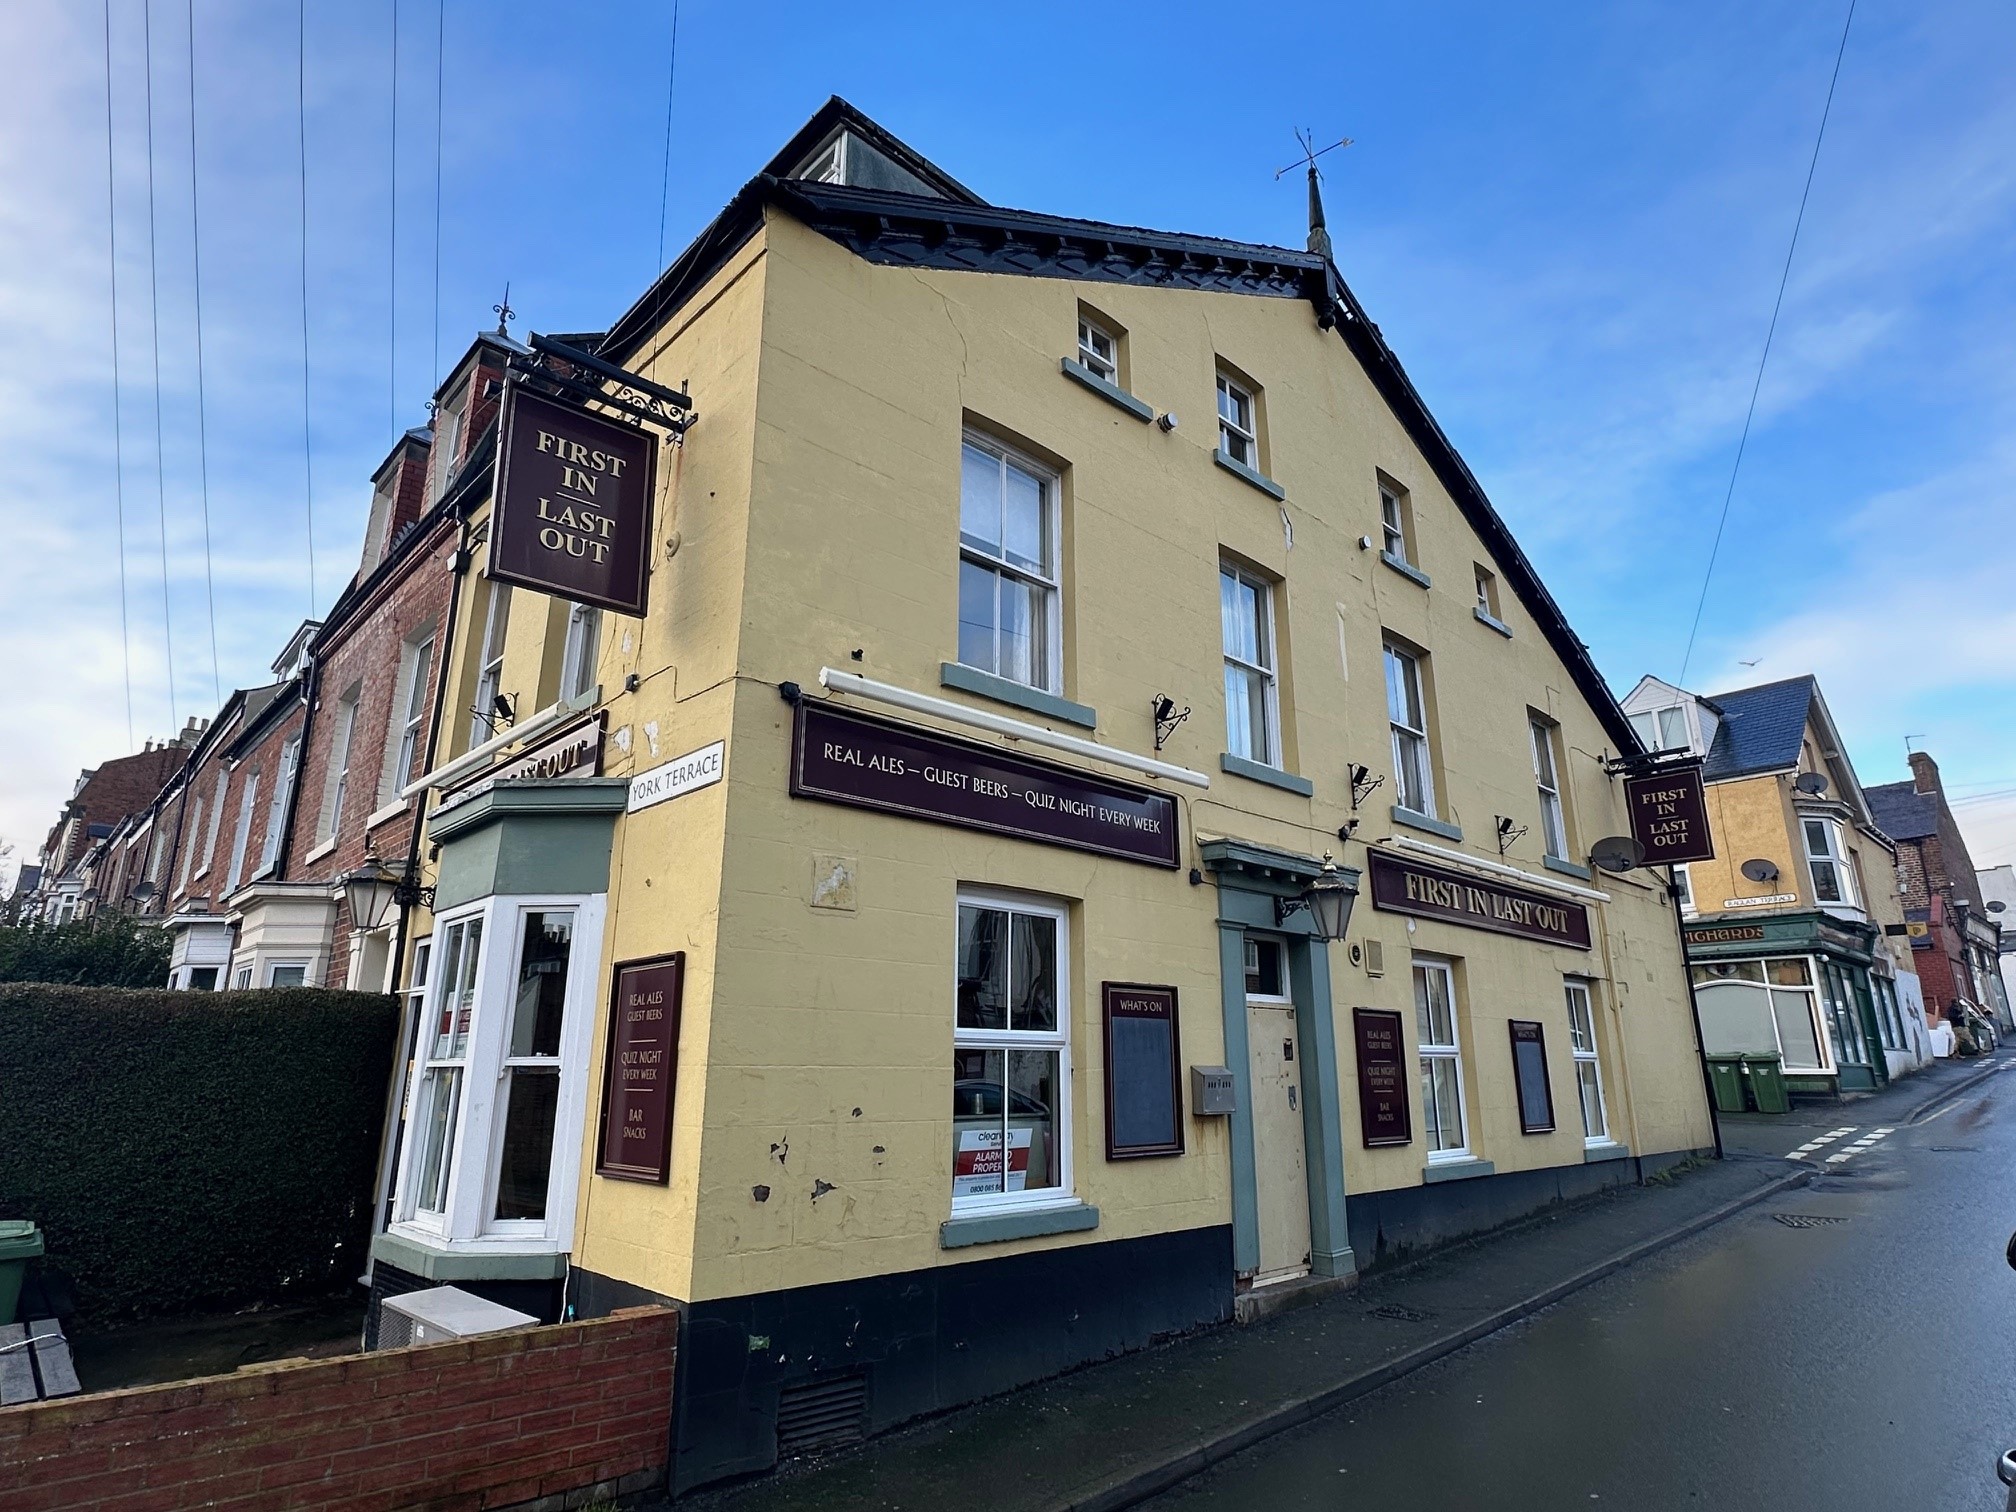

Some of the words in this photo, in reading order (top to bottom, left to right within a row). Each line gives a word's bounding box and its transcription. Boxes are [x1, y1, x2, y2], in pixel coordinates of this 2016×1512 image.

[536, 430, 626, 478] FIRST
[562, 466, 598, 496] IN
[536, 498, 616, 539] LAST
[540, 528, 610, 564] OUT
[546, 739, 588, 779] OUT
[633, 776, 661, 802] YORK
[665, 753, 719, 790] TERRACE
[823, 742, 864, 767] REAL
[868, 754, 905, 775] ALES
[924, 766, 968, 790] GUEST
[973, 777, 1008, 799] BEERS
[1025, 790, 1056, 810] QUIZ
[1059, 798, 1096, 819] NIGHT
[1100, 807, 1131, 827] EVERY
[1133, 814, 1161, 834] WEEK
[1641, 788, 1687, 804] FIRST
[1657, 803, 1675, 815] IN
[1649, 819, 1689, 834] LAST
[1654, 832, 1689, 846] OUT
[1403, 871, 1461, 910] FIRST
[1465, 886, 1489, 917] IN
[1490, 892, 1533, 926] LAST
[1535, 905, 1568, 934] OUT
[630, 993, 646, 1006] REAL
[647, 990, 663, 1005] ALES
[1119, 999, 1148, 1011] WHAT'S
[1149, 1001, 1163, 1012] ON
[627, 1010, 646, 1022] GUEST
[646, 1008, 663, 1020] BEERS
[620, 1051, 638, 1066] QUIZ
[639, 1050, 662, 1064] NIGHT
[622, 1068, 640, 1080] EVERY
[640, 1068, 657, 1080] WEEK
[628, 1108, 643, 1122] BAR
[623, 1126, 647, 1139] SNACKS
[975, 1151, 1012, 1162] ALARMD
[973, 1161, 1012, 1173] PROPERY
